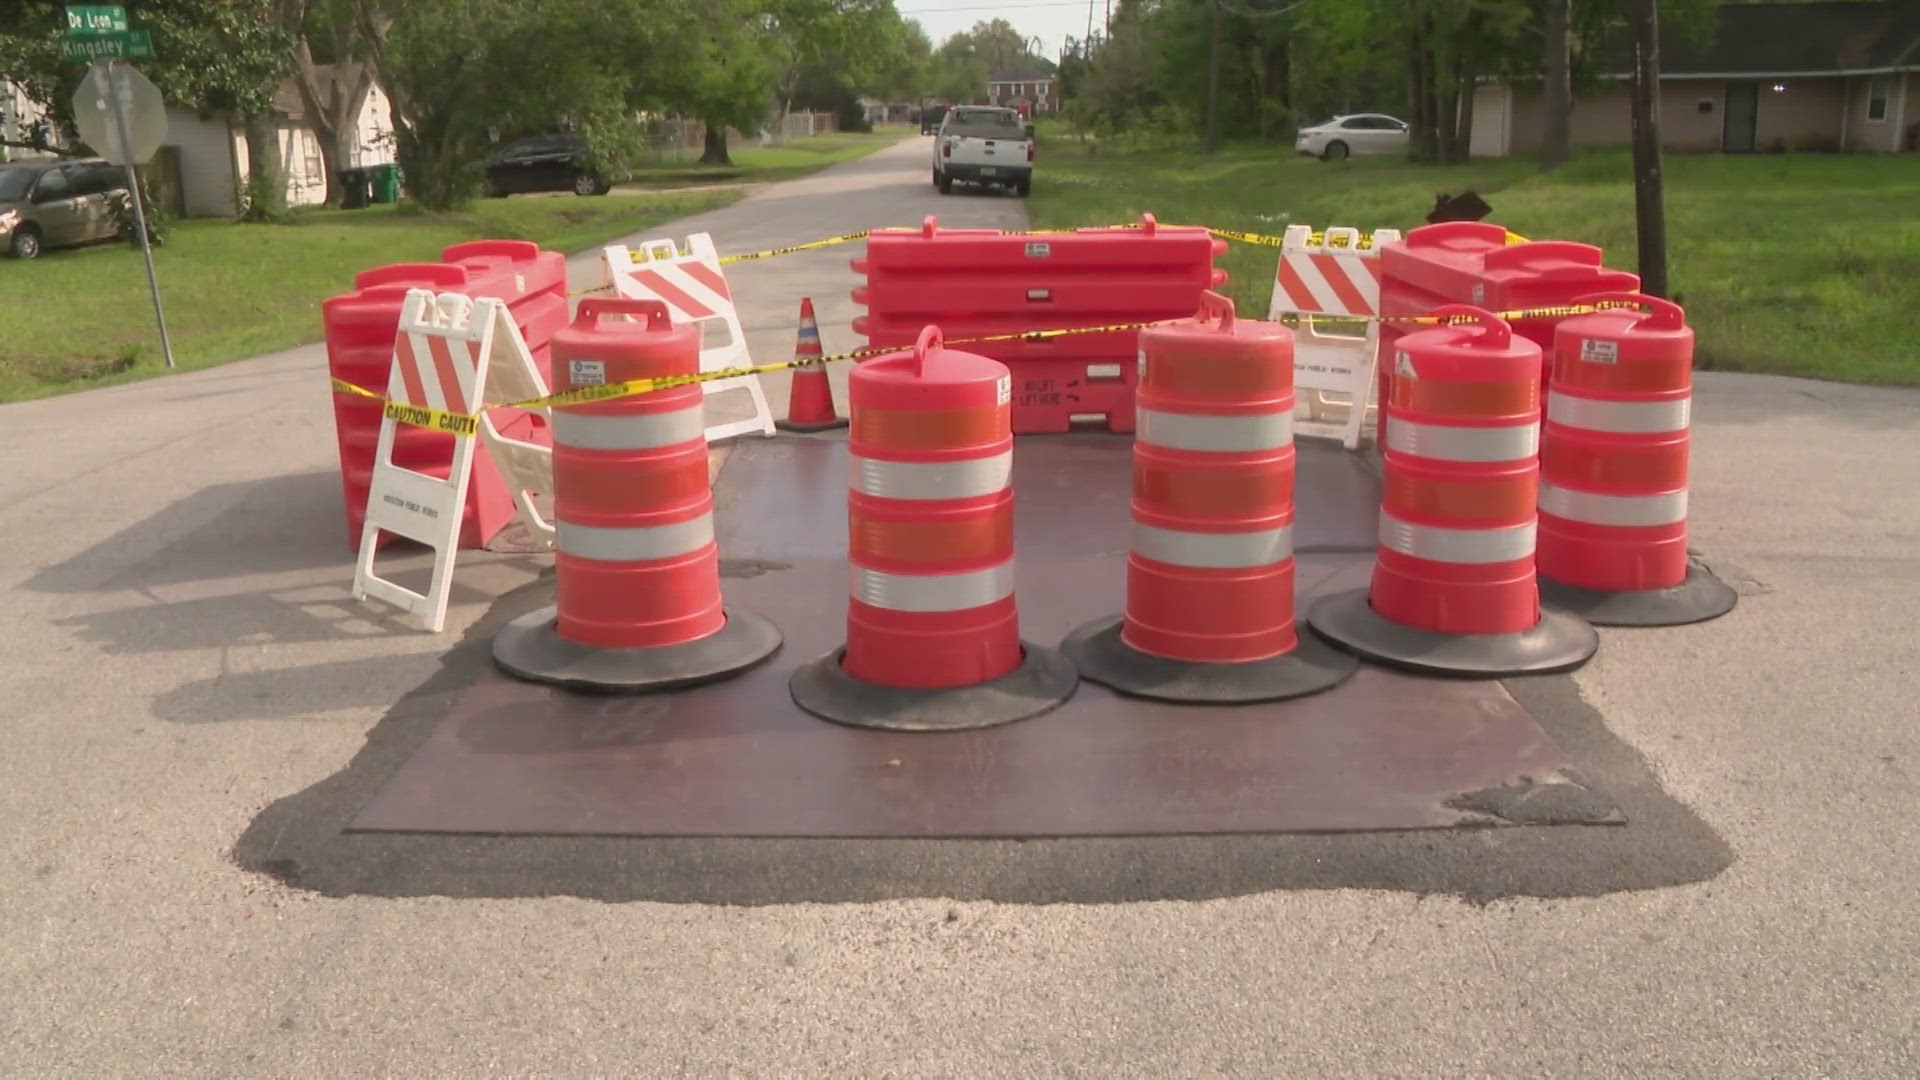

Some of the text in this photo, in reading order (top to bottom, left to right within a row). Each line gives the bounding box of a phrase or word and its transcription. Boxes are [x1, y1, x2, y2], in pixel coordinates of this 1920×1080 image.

[68, 10, 82, 29] De
[86, 10, 112, 29] Leon
[62, 38, 123, 60] Kingsley
[386, 404, 431, 426] CAUTION
